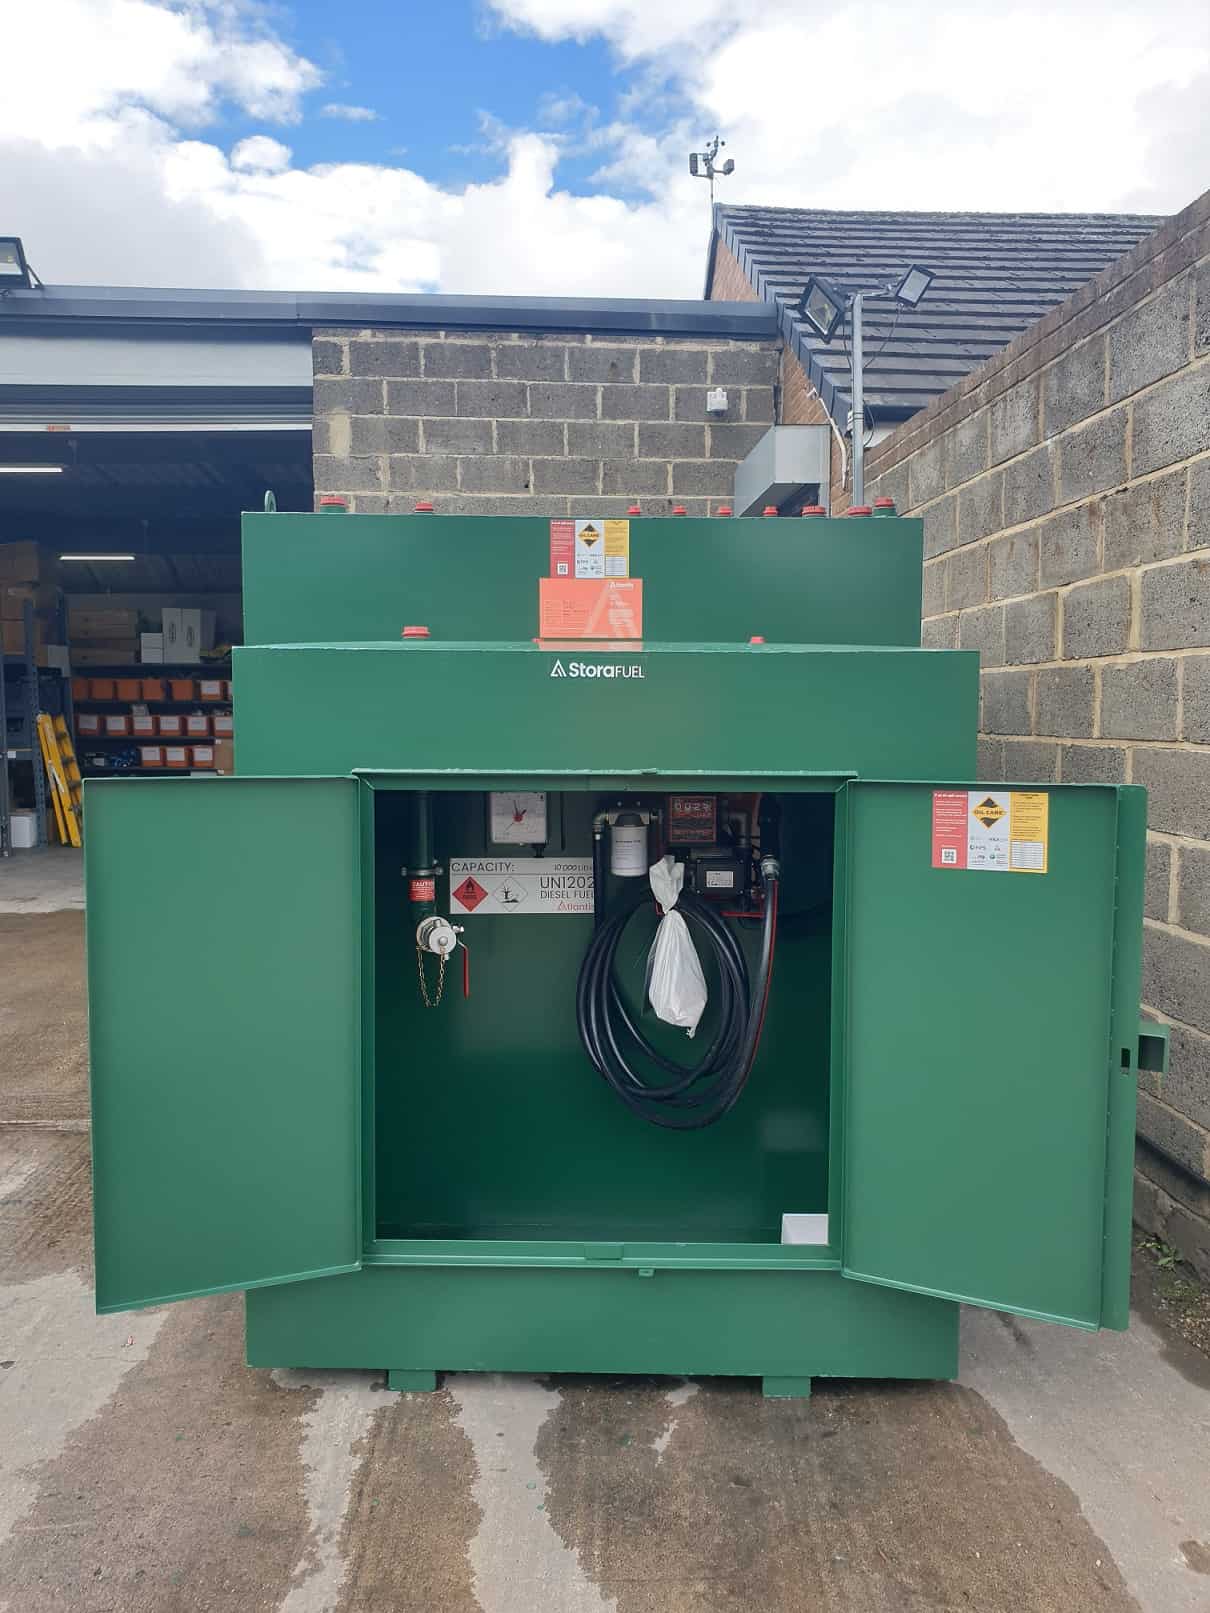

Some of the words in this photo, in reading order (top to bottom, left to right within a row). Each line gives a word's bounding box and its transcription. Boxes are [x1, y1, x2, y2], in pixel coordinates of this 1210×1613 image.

[451, 862, 515, 872] CAPACITY:
[540, 890, 570, 899] DIESEL
[558, 901, 594, 911] Atlanti
